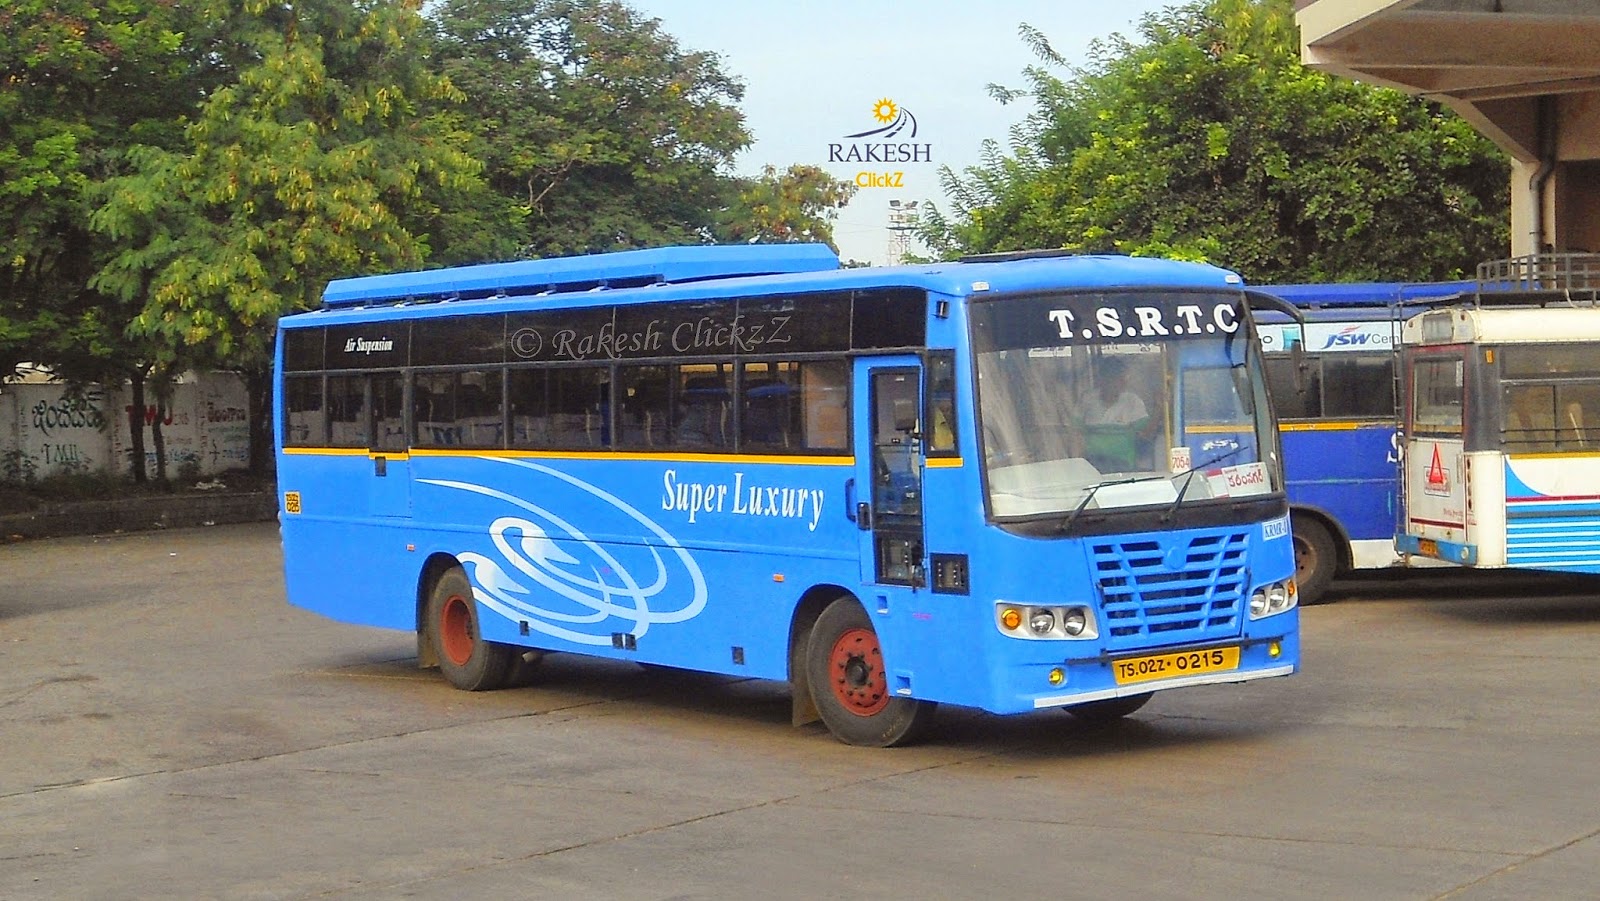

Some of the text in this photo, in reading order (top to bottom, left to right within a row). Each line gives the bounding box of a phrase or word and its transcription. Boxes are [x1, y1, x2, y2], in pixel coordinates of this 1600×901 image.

[1048, 303, 1240, 339] T.S.R.T.C
[343, 335, 394, 355] Air Suspension
[1320, 333, 1372, 350] JSW
[1171, 456, 1190, 469] 7054
[661, 469, 826, 532] Super Luxury
[1176, 649, 1225, 671] 0215
